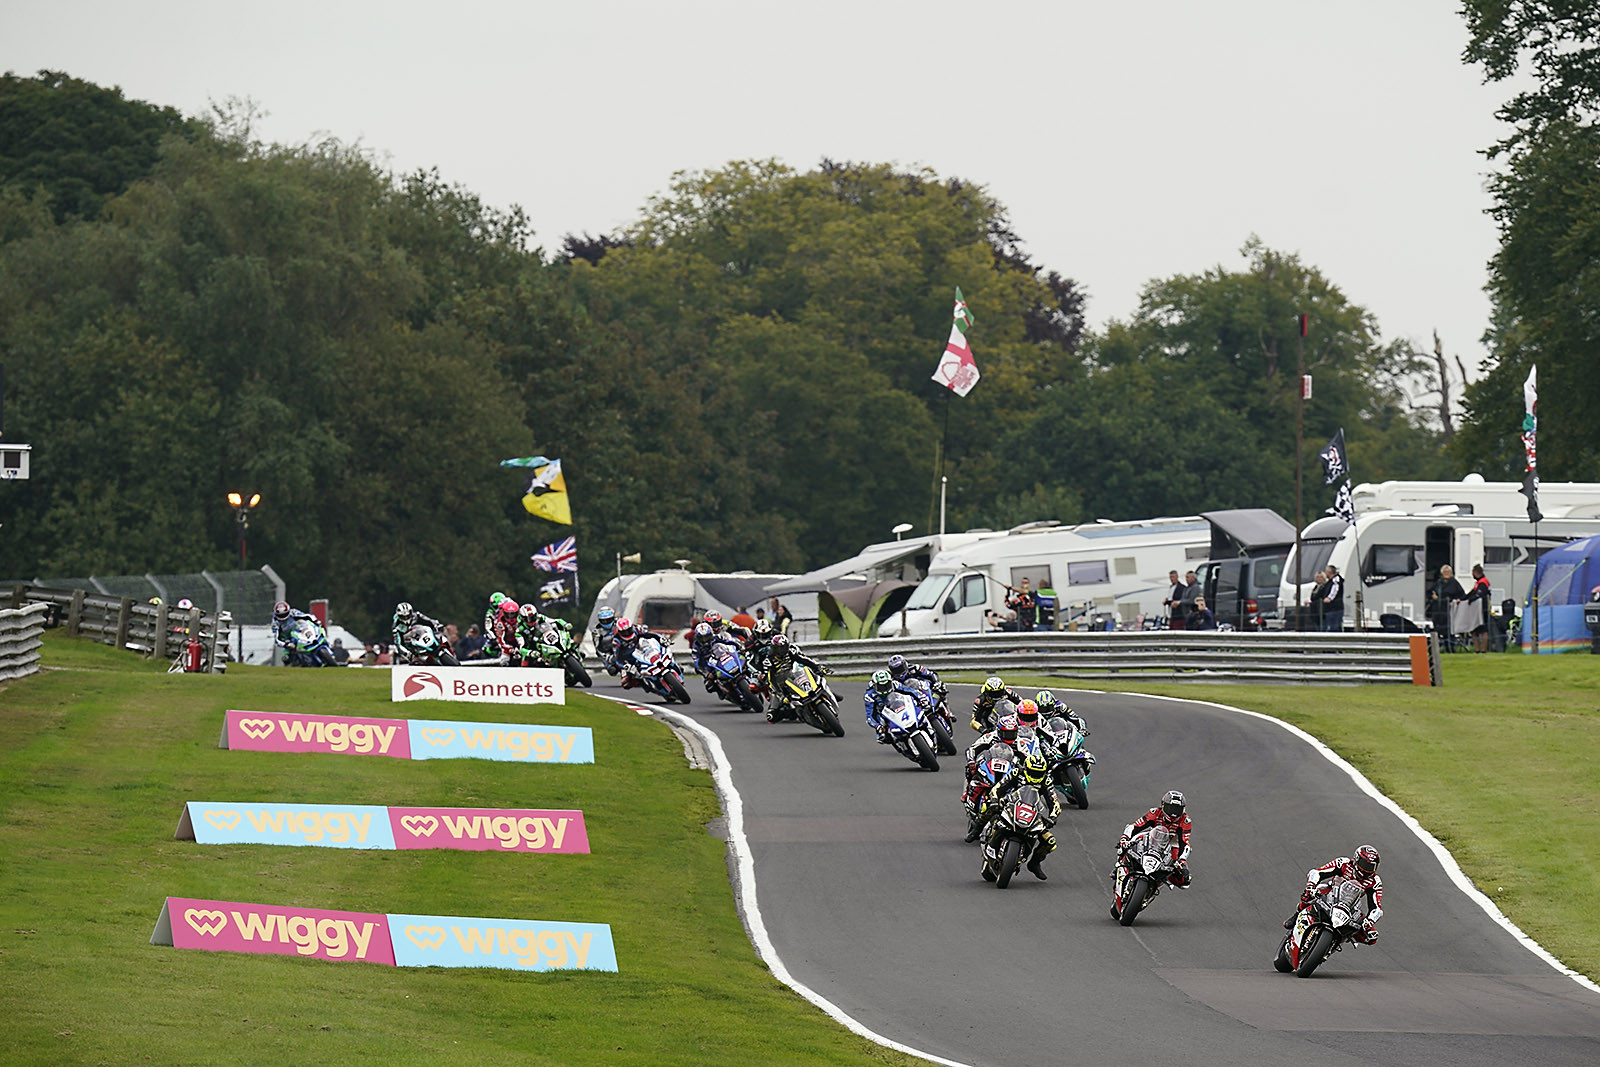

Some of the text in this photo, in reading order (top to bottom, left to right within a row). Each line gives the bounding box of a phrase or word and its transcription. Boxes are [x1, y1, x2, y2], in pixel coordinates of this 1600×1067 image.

[453, 680, 554, 698] Bennetts
[901, 712, 910, 722] 4
[278, 719, 398, 754] wiggy
[460, 728, 577, 762] wiggy
[245, 810, 373, 843] wiggy
[1018, 810, 1033, 819] 77
[442, 815, 569, 849] wiggy
[231, 911, 376, 959] wiggy
[451, 926, 594, 968] wiggy
